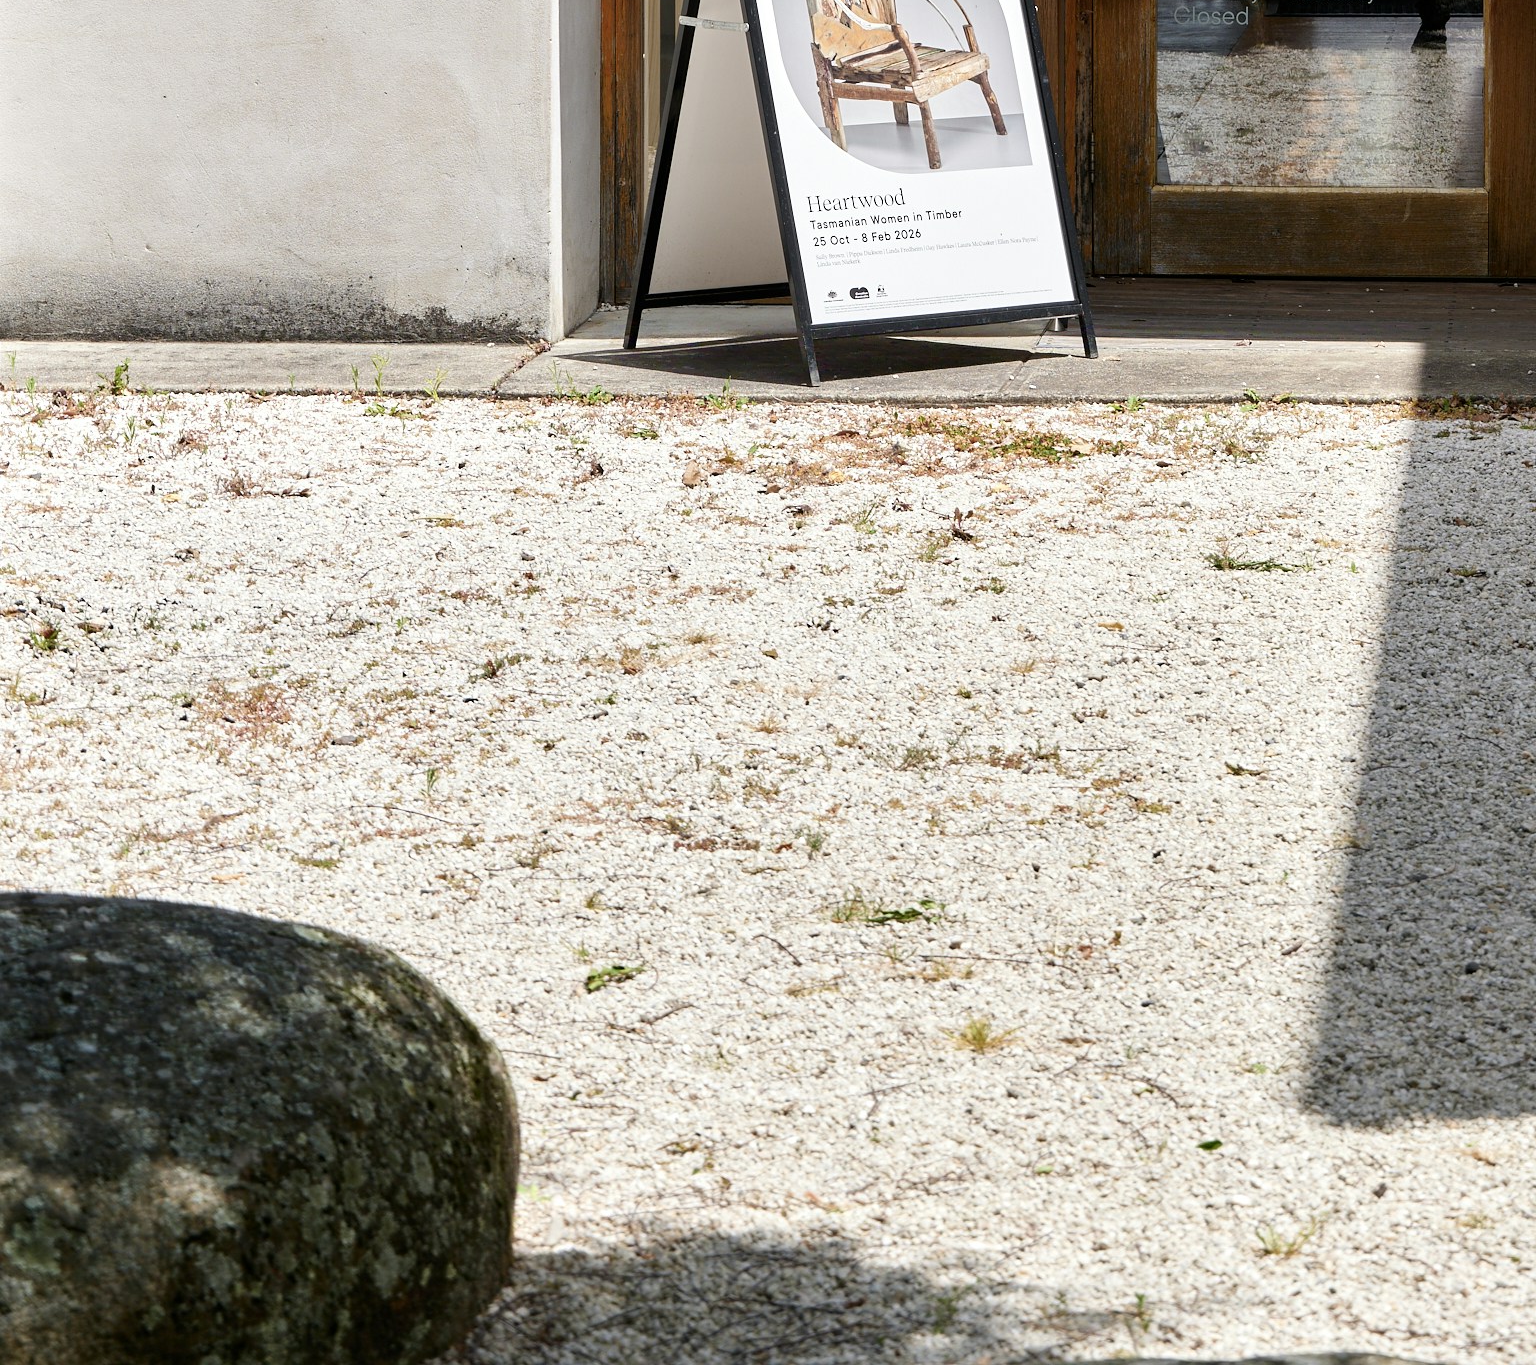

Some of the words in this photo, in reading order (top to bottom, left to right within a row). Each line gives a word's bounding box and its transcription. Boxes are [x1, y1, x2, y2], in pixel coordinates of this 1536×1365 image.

[1174, 6, 1250, 26] Closed
[807, 188, 906, 213] Heartwood
[810, 217, 868, 230] Tasmanian
[870, 214, 910, 225] Women
[913, 212, 923, 222] in
[925, 209, 963, 221] Timber
[813, 236, 827, 247] 25
[830, 235, 850, 246] Oct
[861, 232, 868, 243] 8
[871, 231, 892, 242] Feb
[894, 228, 922, 240] 2026
